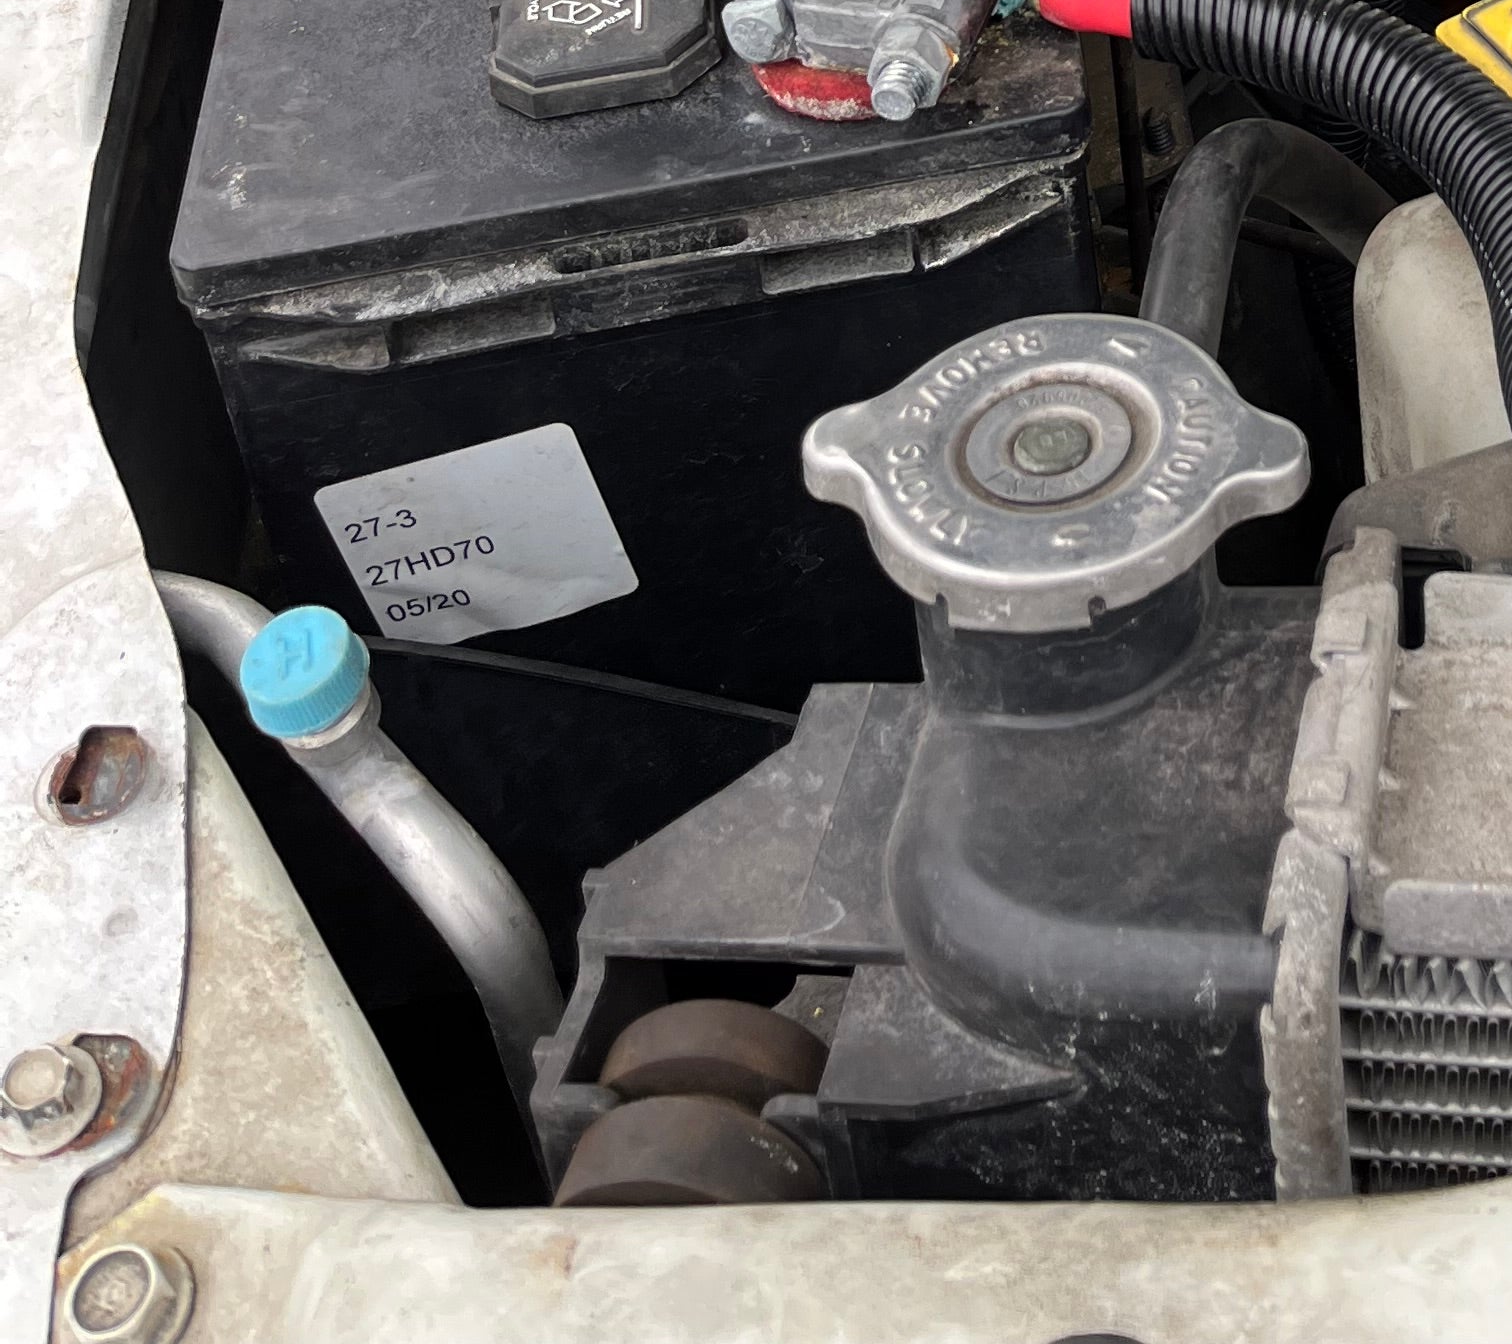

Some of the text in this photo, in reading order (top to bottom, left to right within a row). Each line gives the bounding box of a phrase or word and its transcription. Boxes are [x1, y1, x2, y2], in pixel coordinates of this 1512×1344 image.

[899, 330, 1047, 424] REMOVE
[1145, 376, 1216, 503] CAUTION
[887, 442, 968, 547] SLOWLY
[344, 509, 418, 544] 27-3
[365, 535, 495, 587] 27HD70
[385, 588, 472, 623] 05/20
[276, 626, 313, 681] H
